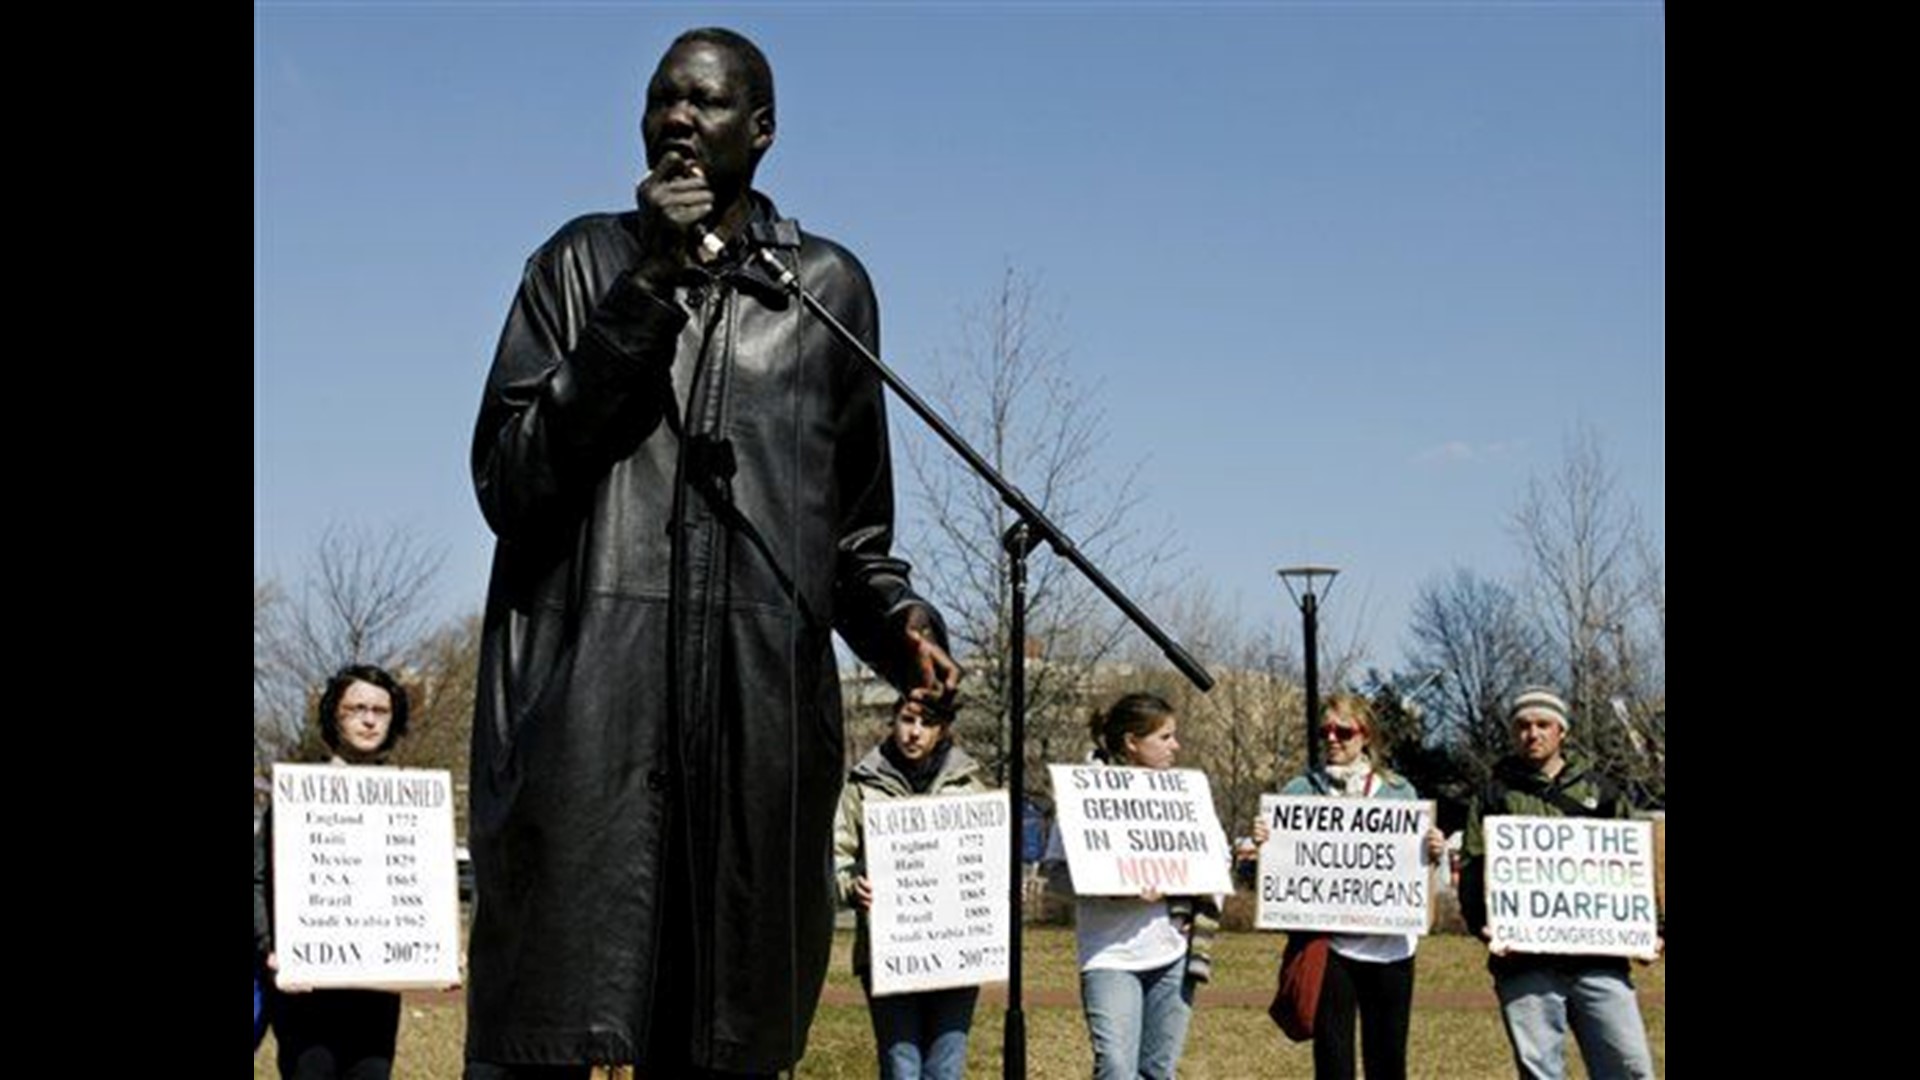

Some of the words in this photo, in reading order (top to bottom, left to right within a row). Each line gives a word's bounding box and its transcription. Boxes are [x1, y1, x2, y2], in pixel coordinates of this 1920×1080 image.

[279, 773, 350, 804] SLAVERY
[354, 776, 445, 808] ABOLISHED
[1072, 768, 1135, 790] STOP
[1142, 771, 1188, 792] THE
[306, 811, 364, 826] England
[387, 813, 418, 827] 1772
[868, 806, 926, 836] SLAVERY
[932, 801, 1006, 830] ABOLISHED
[1083, 797, 1198, 822] GENOCIDE
[309, 833, 346, 845] Haiti
[385, 834, 416, 846] 1804
[891, 838, 939, 854] England
[1084, 829, 1111, 851] IN
[1127, 828, 1209, 853] SUDAN
[1496, 823, 1574, 851] STOP
[1583, 825, 1639, 855] THE
[311, 852, 362, 865] Mexico
[1295, 841, 1396, 870] INCLUDES
[896, 876, 938, 889] Mexico
[1117, 857, 1189, 886] NOW
[1493, 856, 1645, 888] GENOCIDE
[309, 895, 352, 907] Brazil
[1263, 875, 1324, 904] BLACK
[1491, 890, 1518, 917] IN
[1530, 890, 1651, 922] DARFUR
[299, 915, 339, 927] Saudi
[345, 915, 390, 927] Arabia
[1496, 925, 1533, 943] CALL
[1536, 926, 1617, 945] CONGRESS
[1618, 930, 1651, 946] NOW
[292, 942, 361, 964] SUDAN
[885, 952, 942, 976] SUDAN
